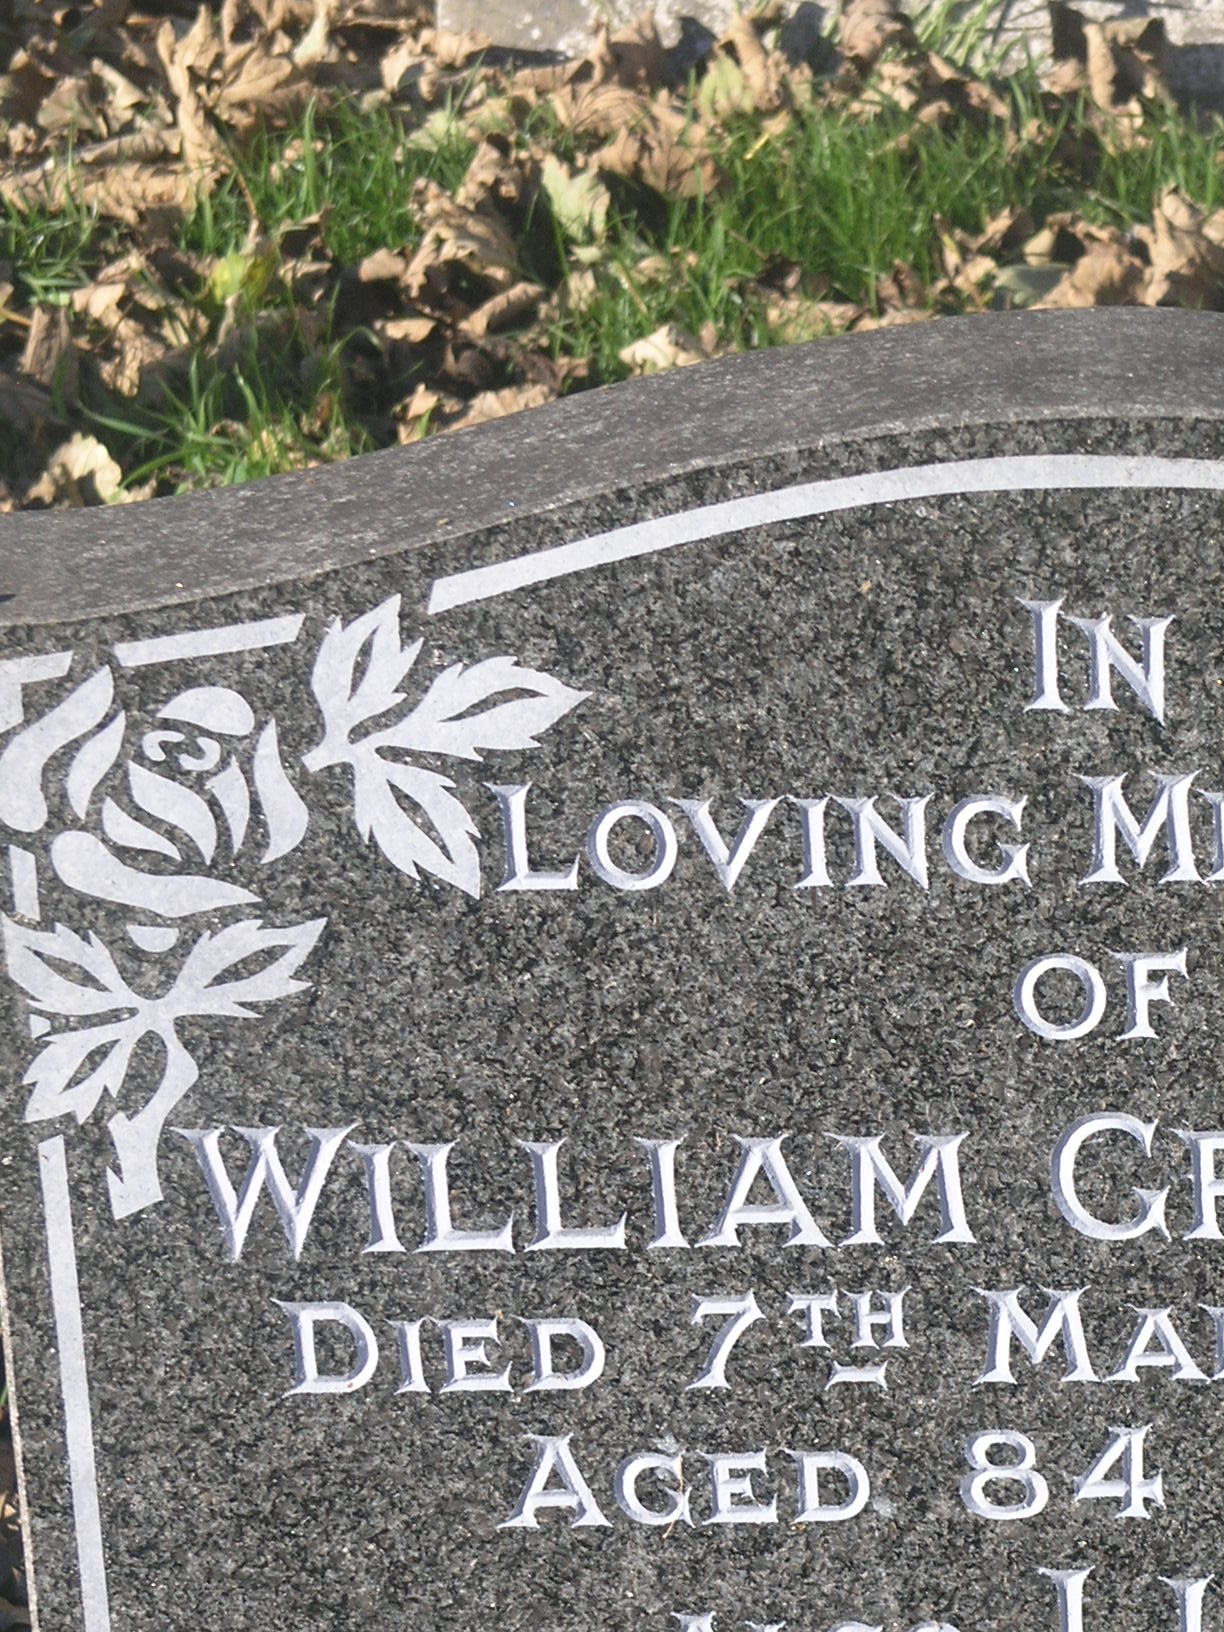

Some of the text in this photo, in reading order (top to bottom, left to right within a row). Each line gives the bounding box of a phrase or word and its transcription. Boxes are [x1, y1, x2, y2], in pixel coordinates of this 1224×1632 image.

[1015, 597, 1173, 724] IN
[482, 782, 1035, 892] LOVING
[1014, 948, 1188, 1040] OF
[171, 1121, 977, 1261] WILLIAM
[272, 1297, 607, 1397] DIED
[684, 1286, 912, 1390] 7TH
[496, 1433, 872, 1531] AGED
[960, 1424, 1166, 1520] 84
